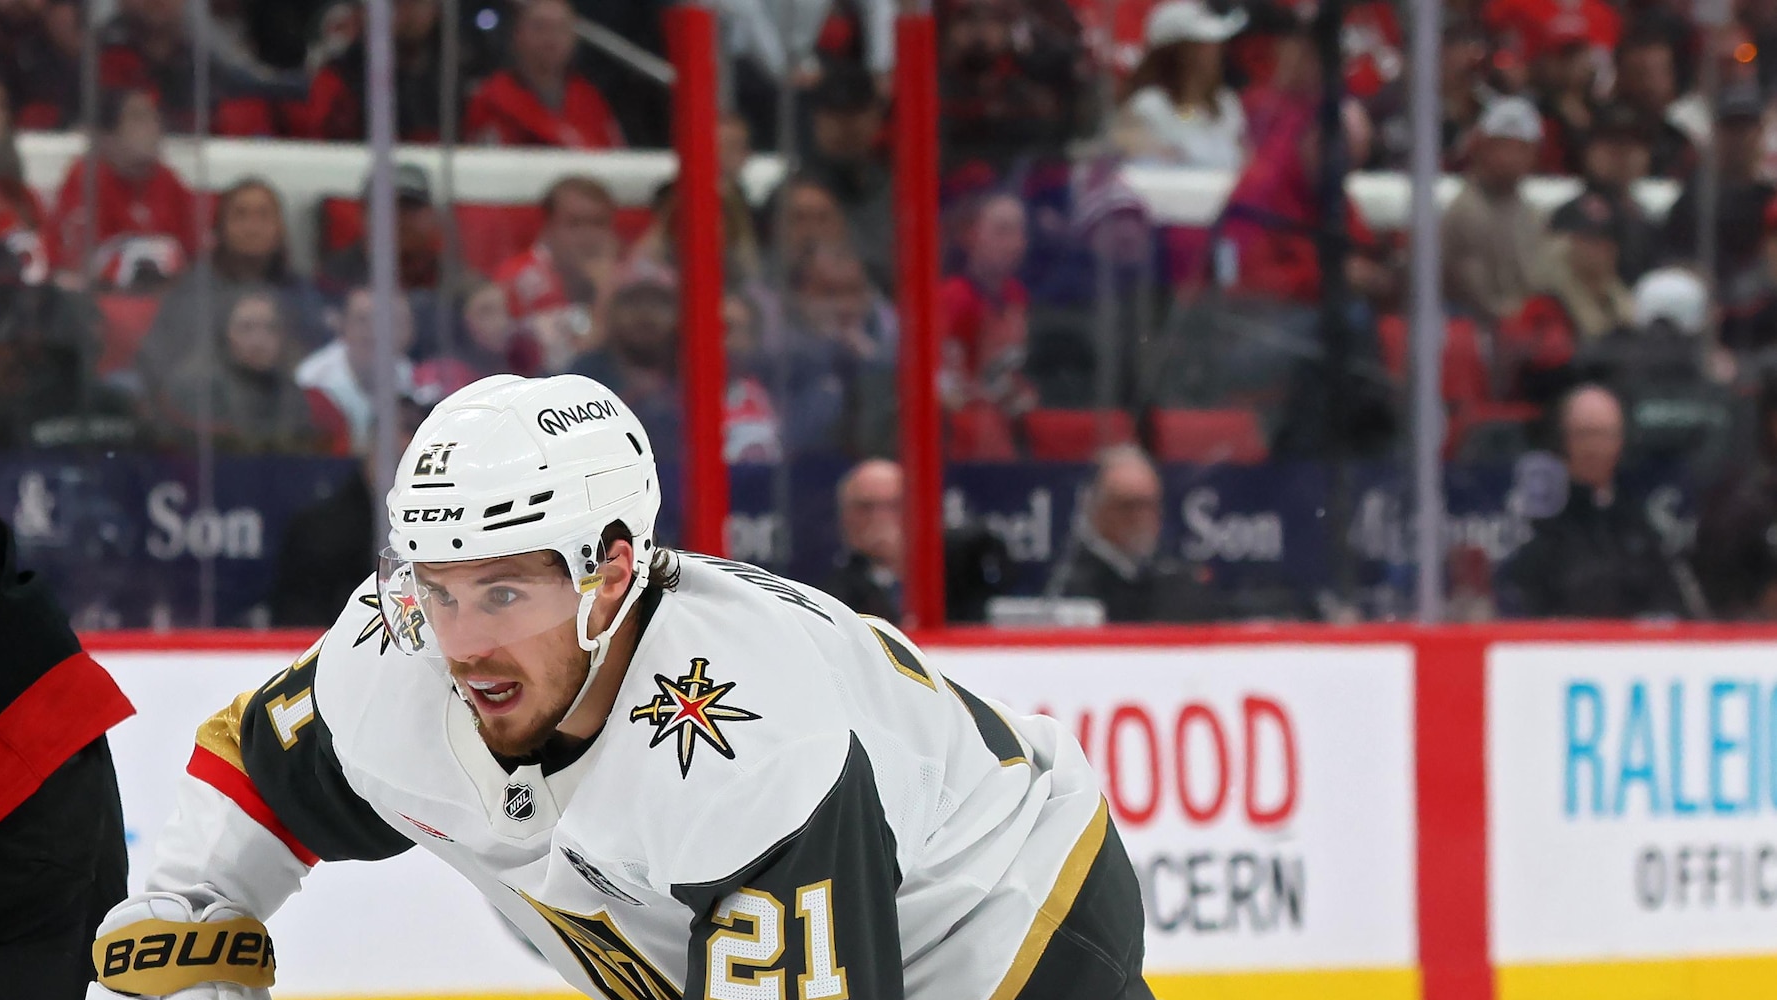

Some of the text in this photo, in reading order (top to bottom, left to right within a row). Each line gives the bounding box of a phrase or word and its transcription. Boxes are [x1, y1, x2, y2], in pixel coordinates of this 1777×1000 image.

[558, 399, 619, 427] NAQVI
[413, 442, 459, 477] 21
[145, 481, 264, 560] Son
[401, 506, 465, 523] CCM
[1180, 486, 1284, 562] Son
[1563, 678, 1777, 816] RALEI
[509, 792, 530, 815] NHL
[1134, 852, 1305, 934] CERN
